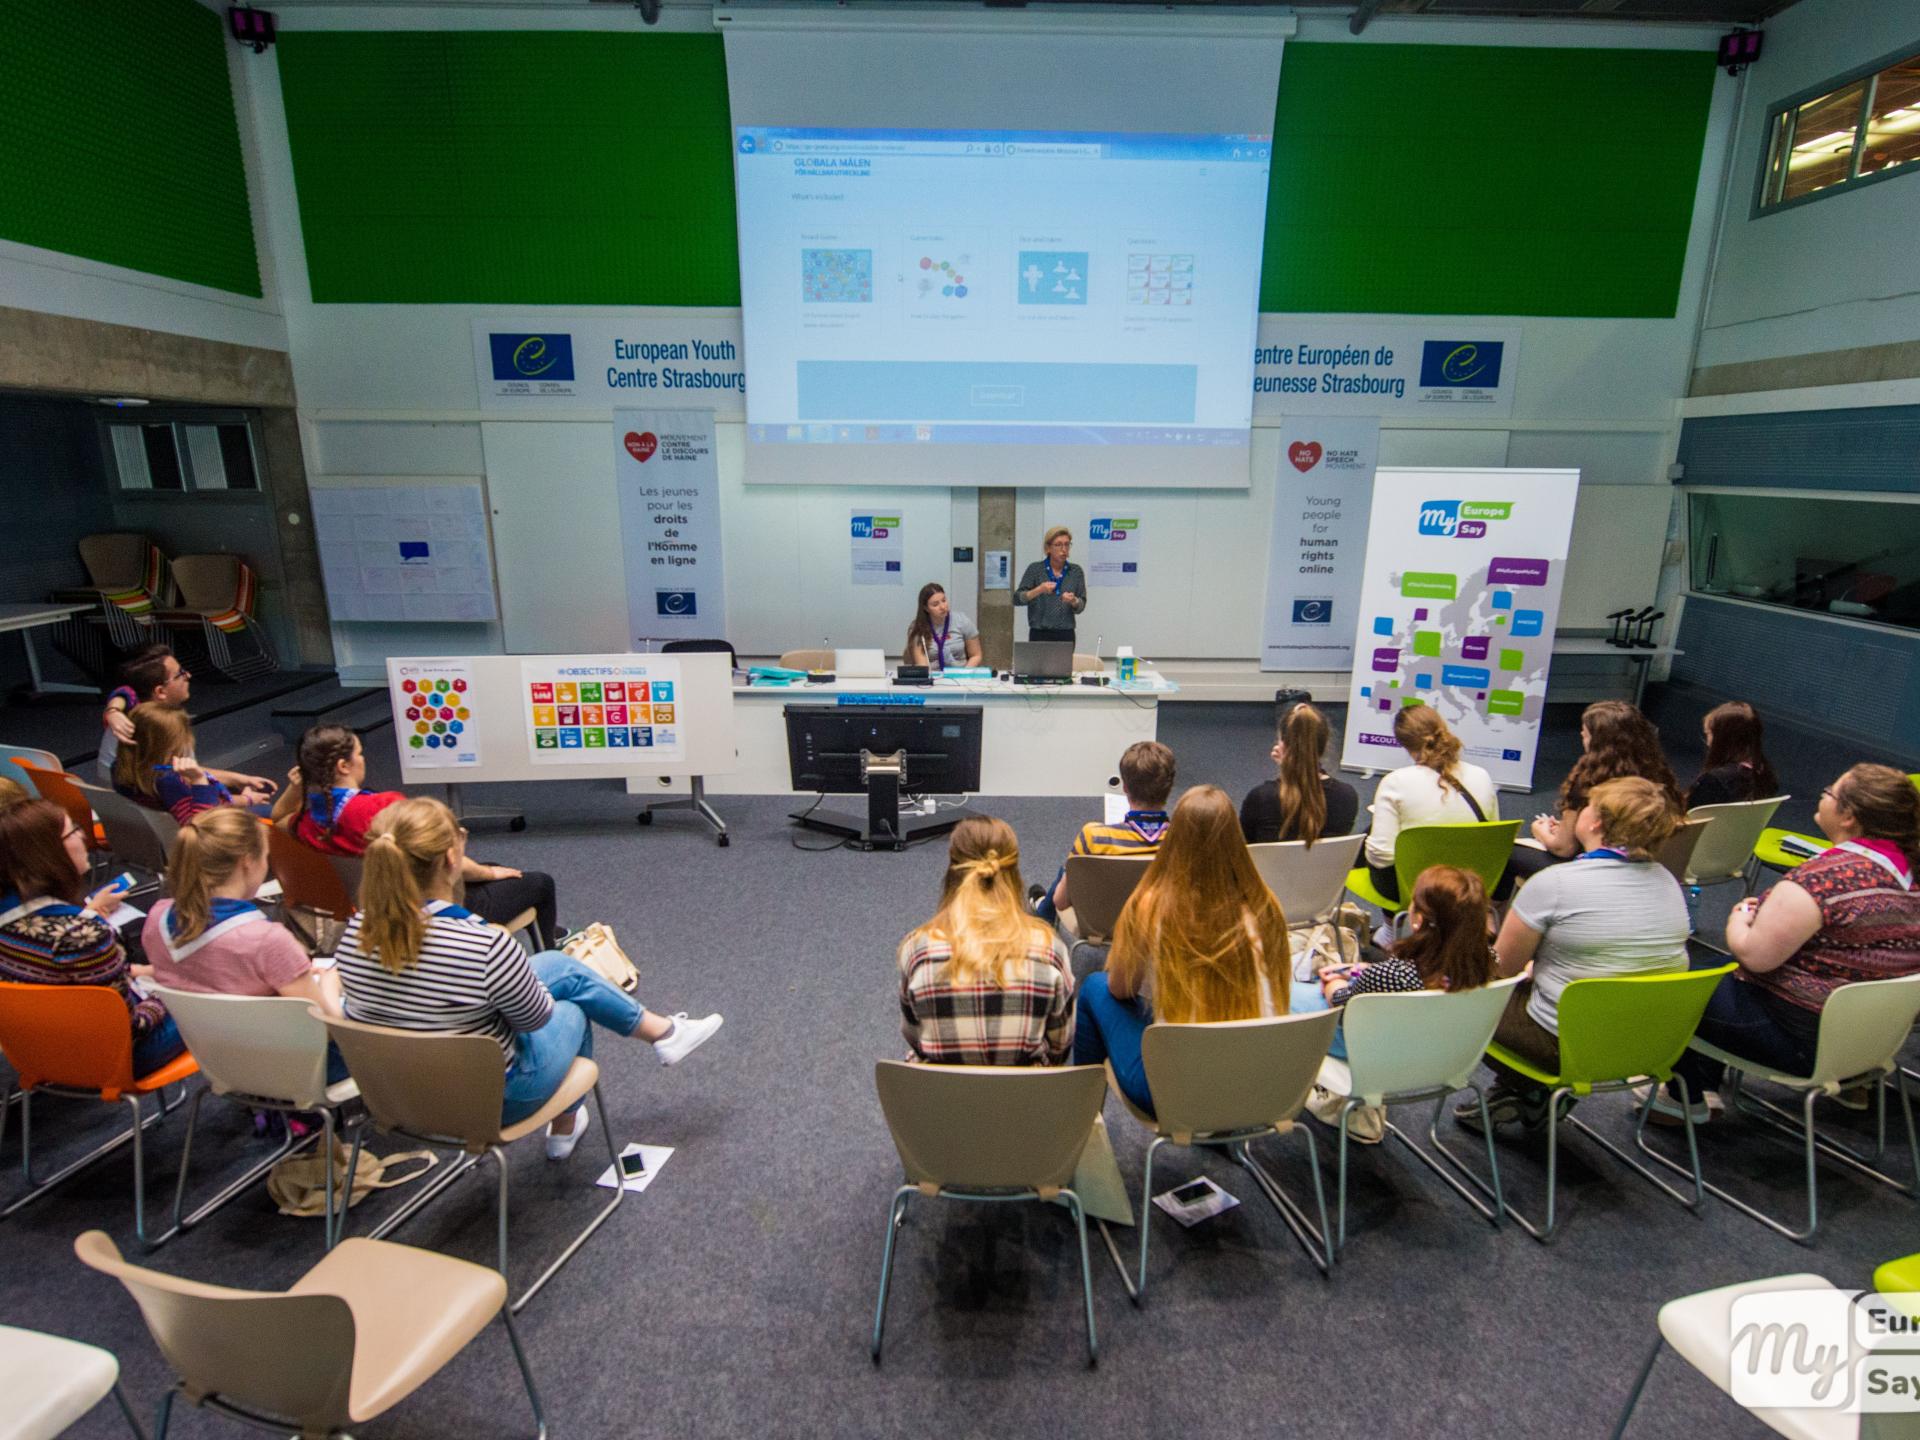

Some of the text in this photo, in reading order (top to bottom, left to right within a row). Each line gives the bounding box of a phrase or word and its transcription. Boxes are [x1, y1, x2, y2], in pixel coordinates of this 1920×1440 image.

[794, 158, 837, 167] GLOBALA
[615, 339, 736, 364] European Youth
[1254, 344, 1394, 369] entre Européen de
[607, 368, 745, 393] Centre Strasbourg
[1254, 373, 1405, 398] eunesse Strasbourg
[639, 486, 699, 499] Les jeunes
[647, 500, 693, 514] pour les
[1305, 496, 1341, 508] Young
[654, 514, 688, 524] droits
[1302, 510, 1341, 521] people
[1419, 506, 1505, 535] My Europe
[664, 527, 679, 537] de
[853, 521, 871, 536] My
[1091, 523, 1109, 537] My
[1312, 523, 1328, 533] for
[1460, 524, 1483, 535] Say
[647, 541, 698, 551] l'Homme
[1299, 538, 1338, 547] human
[651, 555, 697, 567] en ligne
[1301, 551, 1334, 562] rights
[1299, 564, 1334, 574] online
[567, 667, 613, 675] OBJECTIFS
[1370, 735, 1400, 745] SCOUT
